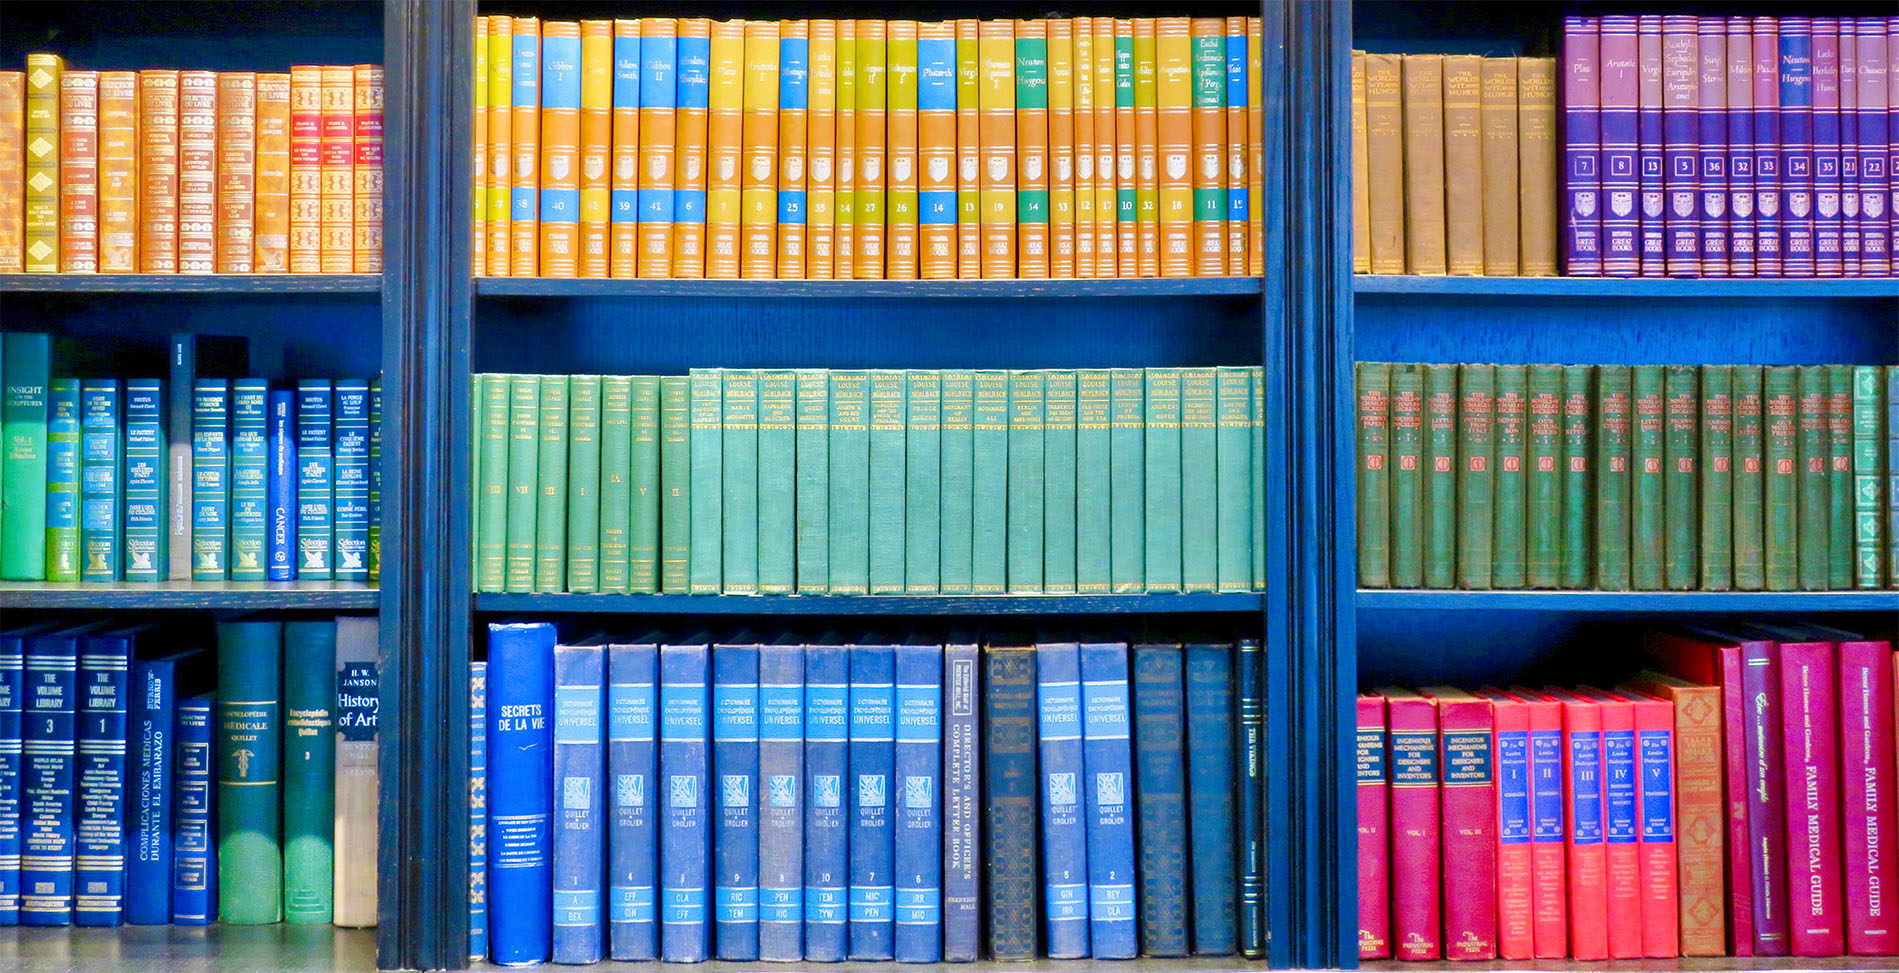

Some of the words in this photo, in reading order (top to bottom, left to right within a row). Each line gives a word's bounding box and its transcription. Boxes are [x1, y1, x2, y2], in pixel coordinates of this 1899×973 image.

[1782, 55, 1810, 64] Newton
[922, 66, 952, 78] Plutarch
[1858, 66, 1888, 74] Chaucer
[617, 71, 638, 80] Smith
[1782, 74, 1811, 86] Huygens
[1582, 162, 1588, 170] 7
[1618, 162, 1624, 170] 8
[1648, 162, 1658, 171] 13
[1682, 162, 1688, 170] 5
[1708, 162, 1720, 171] 36
[1738, 162, 1748, 171] 32
[1764, 162, 1774, 170] 33
[1794, 162, 1806, 171] 34
[1823, 162, 1833, 172] 35
[1845, 162, 1855, 172] 21
[1868, 163, 1880, 172] 22
[618, 202, 630, 211] 39
[686, 202, 692, 210] 6
[786, 203, 798, 212] 25
[864, 203, 876, 212] 27
[896, 203, 908, 212] 26
[934, 203, 944, 212] 14
[964, 202, 974, 212] 13
[1081, 201, 1090, 210] 12
[1103, 201, 1112, 210] 17
[1122, 201, 1132, 210] 10
[1142, 201, 1154, 210] 32
[1172, 201, 1182, 210] 18
[1207, 200, 1216, 208] 11
[8, 386, 42, 394] INSIGHT
[275, 507, 286, 546] CANCER
[44, 673, 56, 683] THE
[97, 672, 110, 682] THE
[37, 686, 63, 696] VOLUME
[90, 685, 116, 696] VOLUME
[36, 698, 64, 708] LIBRARY
[88, 698, 116, 708] LIBRARY
[338, 694, 380, 714] History
[502, 704, 542, 718] SECRETS
[339, 712, 352, 726] of
[355, 712, 378, 726] Art
[664, 716, 702, 726] UNIVERSEL
[854, 714, 890, 724] UNIVERSEL
[900, 716, 938, 726] UNIVERSEL
[1042, 714, 1078, 723] UNIVERSEL
[46, 718, 54, 734] 3
[99, 718, 106, 733] 1
[498, 718, 510, 732] DE
[515, 718, 528, 730] LA
[532, 717, 545, 730] VIE
[1248, 728, 1256, 744] THE
[142, 720, 152, 769] MEDICAS
[305, 752, 310, 760] 3
[952, 724, 960, 784] COMPLETE
[964, 724, 972, 790] DIRECTOR'S
[152, 731, 162, 790] EMBARAZO
[1248, 744, 1256, 778] VIKINGS
[1543, 768, 1552, 778] II
[1581, 770, 1594, 780] III
[1615, 769, 1627, 778] IV
[1652, 768, 1660, 778] V
[1806, 766, 1818, 810] FAMILY
[1865, 768, 1877, 812] FAMILY
[152, 793, 161, 808] EL
[952, 789, 960, 833] LETTER
[964, 794, 972, 819] AND
[1099, 806, 1124, 814] QUILLET
[140, 770, 150, 862] COMPLICACIONES
[860, 807, 885, 816] QUILLET
[860, 819, 885, 828] GROLIER
[1100, 817, 1124, 825] GROLIER
[151, 810, 162, 862] DURANTE
[1808, 814, 1821, 873] MEDICAL
[1866, 816, 1880, 874] MEDICAL
[952, 838, 960, 870] BOOK
[964, 824, 972, 880] OFFICER'S
[628, 872, 633, 880] 4
[734, 873, 740, 882] 9
[822, 873, 831, 882] 10
[869, 872, 874, 881] 7
[916, 875, 921, 884] 6
[1064, 871, 1070, 880] 5
[1110, 871, 1115, 880] 2
[625, 892, 636, 901] EFF
[676, 894, 689, 902] CLA
[865, 892, 880, 900] MIC
[1061, 890, 1073, 898] GIN
[1106, 890, 1120, 899] BEY
[1810, 876, 1822, 916] GUIDE
[1869, 876, 1880, 916] GUIDE
[912, 895, 924, 904] IRR
[865, 908, 879, 917] PEN
[1062, 906, 1074, 915] IRR
